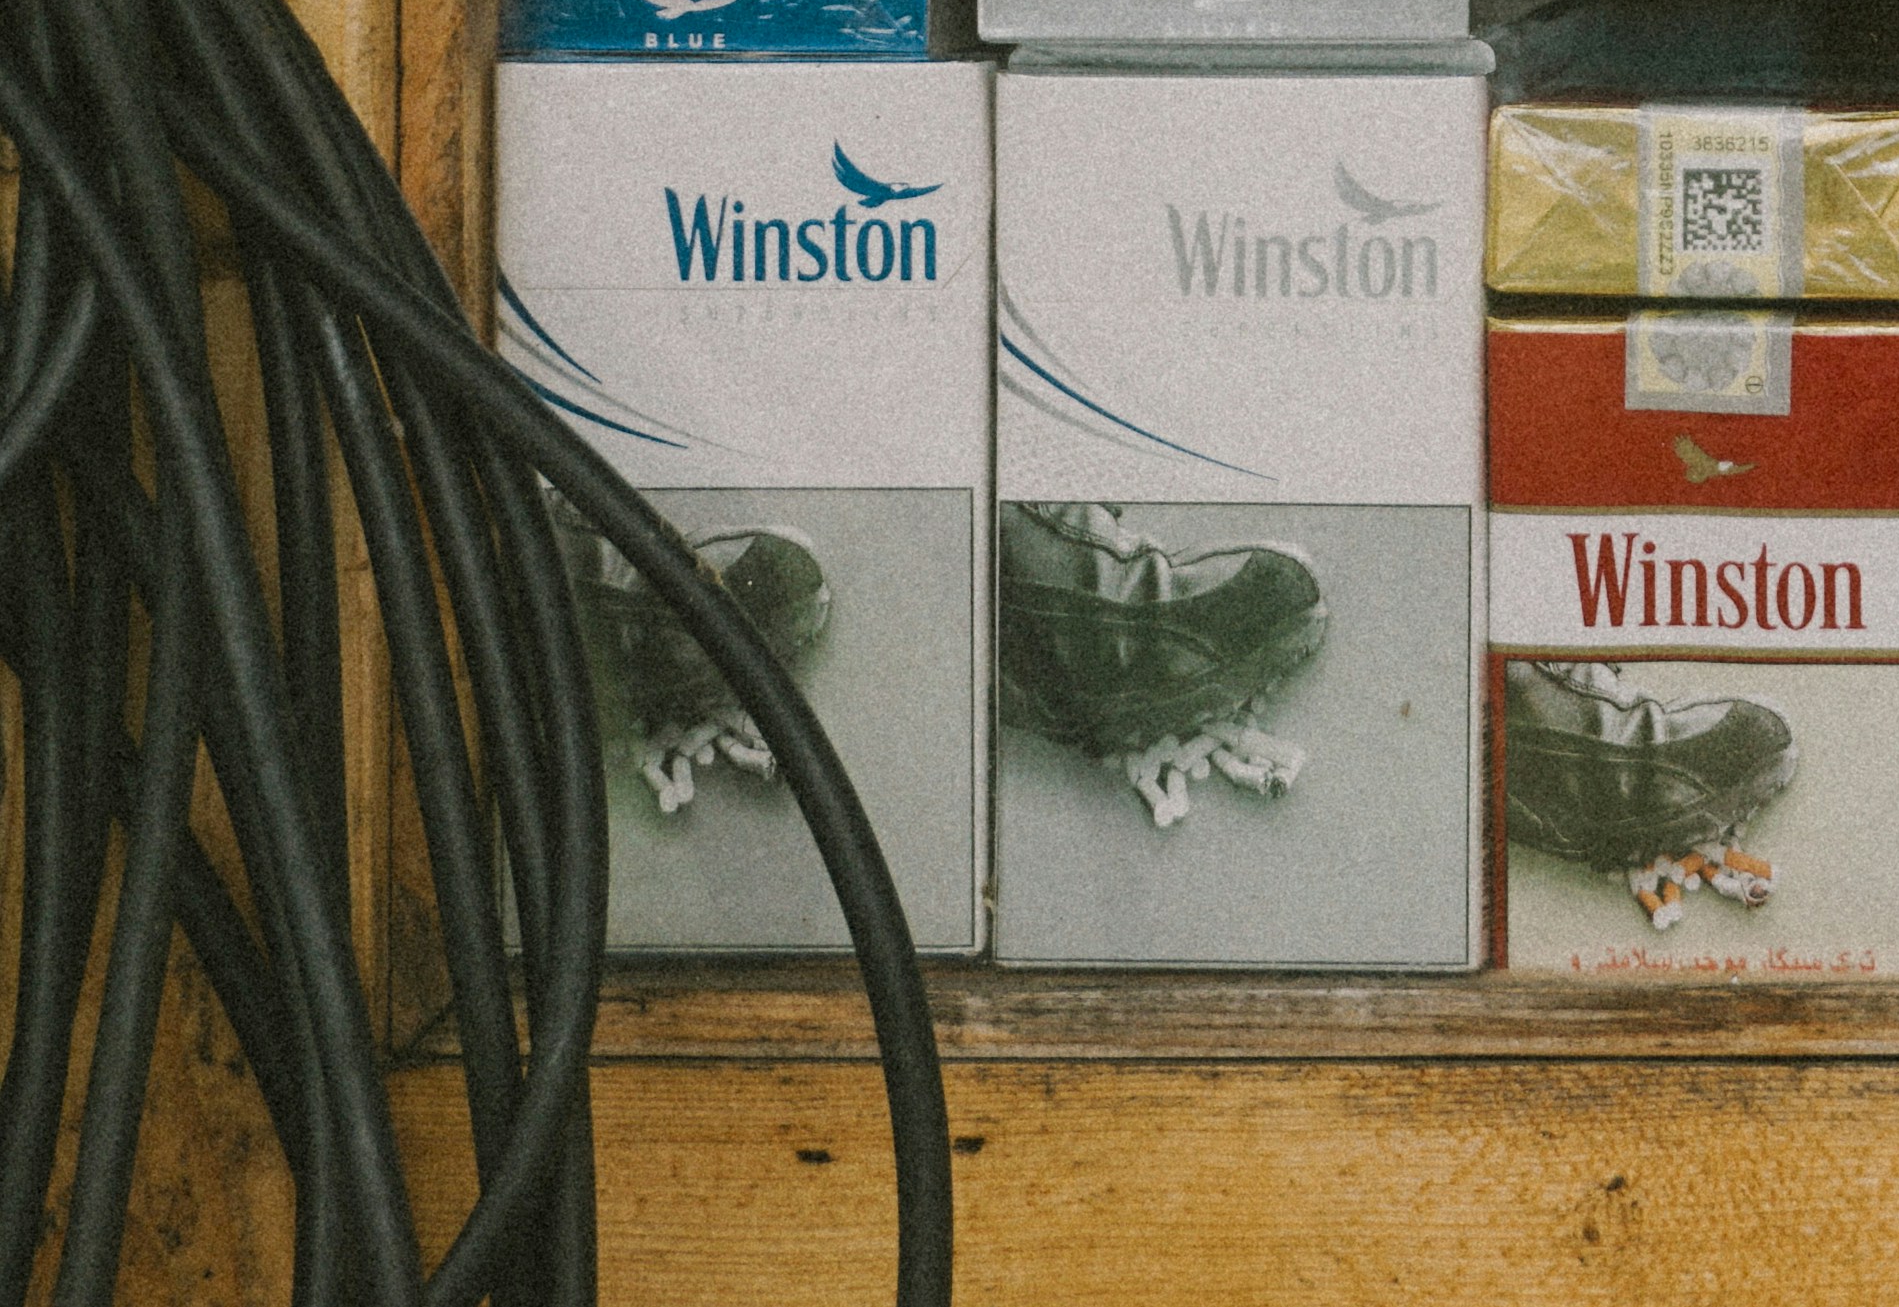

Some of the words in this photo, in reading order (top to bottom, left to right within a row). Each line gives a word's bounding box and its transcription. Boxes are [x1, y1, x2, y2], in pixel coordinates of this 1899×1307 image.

[645, 33, 727, 48] BLUE
[663, 187, 937, 285] Winston
[1167, 204, 1439, 300] Winston
[1568, 531, 1866, 631] Winston
